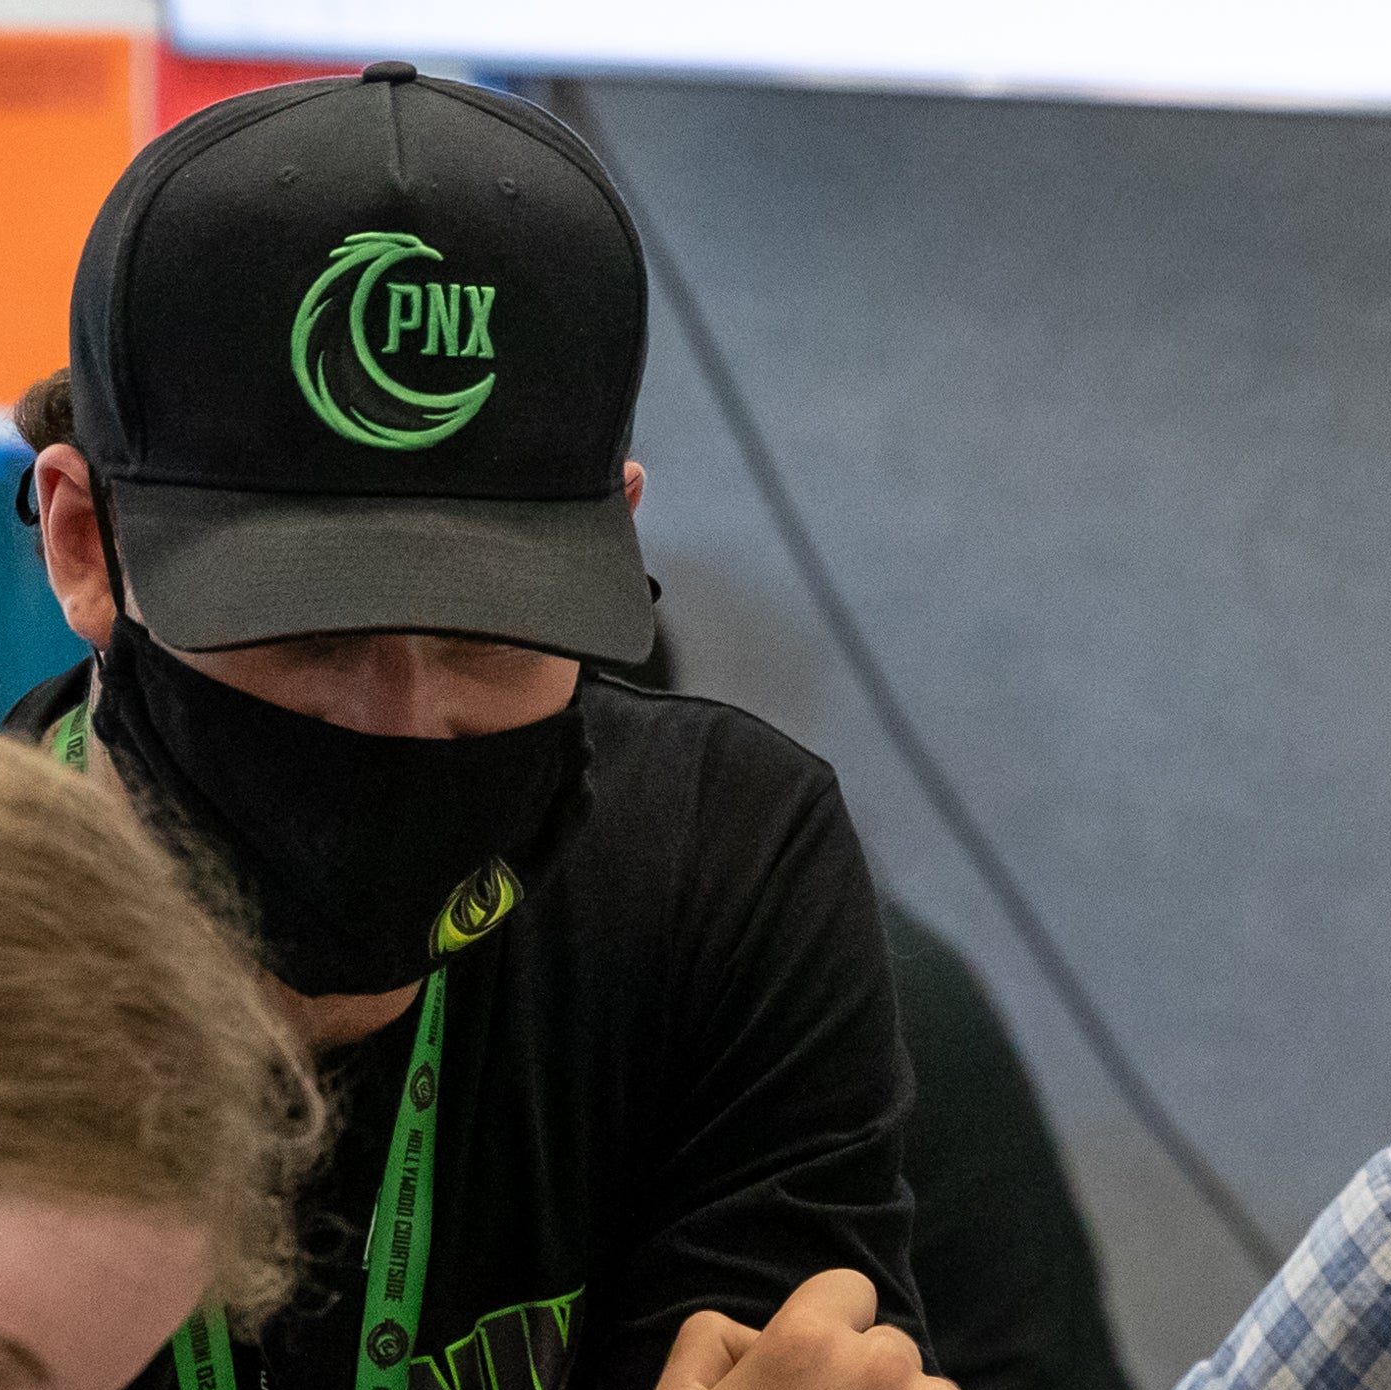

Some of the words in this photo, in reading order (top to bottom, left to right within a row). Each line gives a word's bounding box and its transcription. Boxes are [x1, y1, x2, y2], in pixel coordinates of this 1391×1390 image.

[382, 282, 496, 359] PNX
[395, 1129, 422, 1219] HOLLYWOOD
[384, 1219, 411, 1302] COURTSIDE
